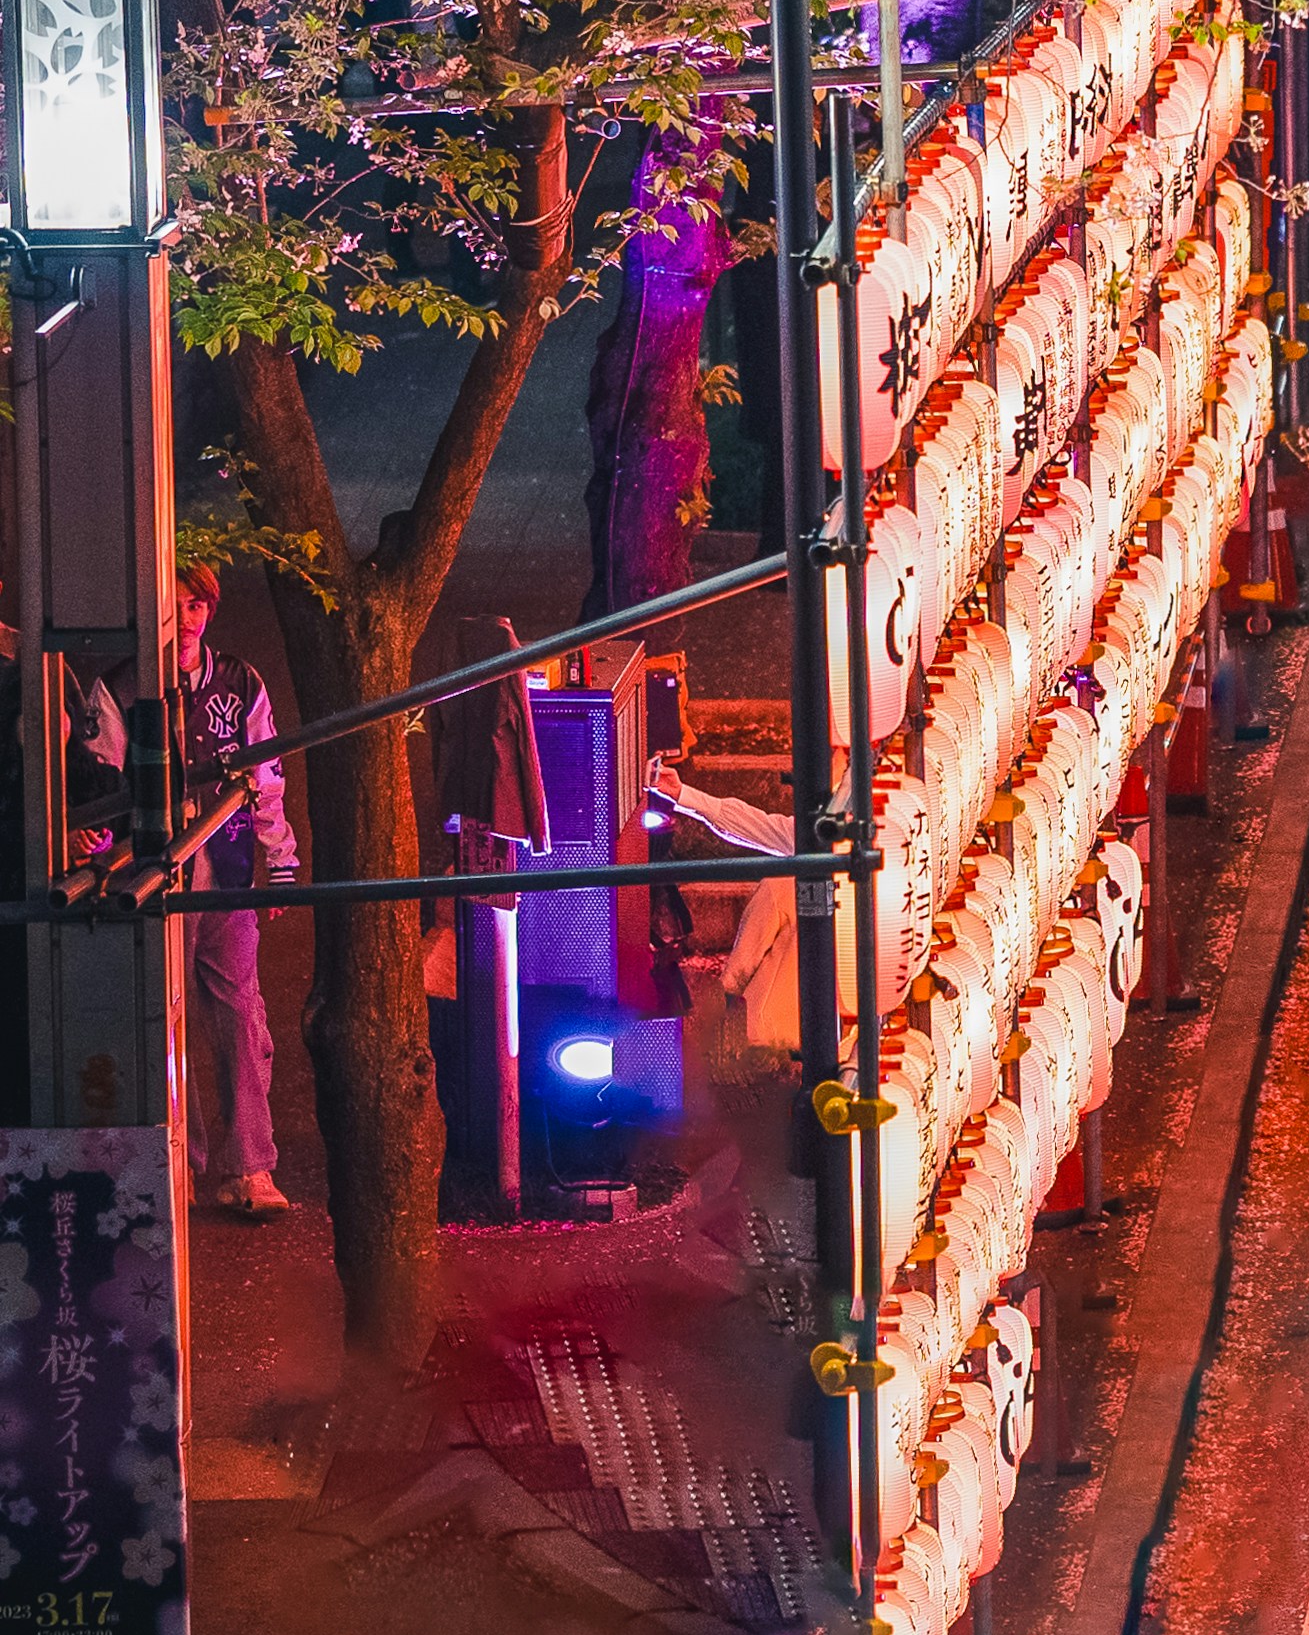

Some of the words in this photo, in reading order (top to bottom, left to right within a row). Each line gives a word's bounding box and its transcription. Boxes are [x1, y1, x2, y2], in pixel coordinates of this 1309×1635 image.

[205, 693, 244, 738] NY
[50, 1191, 79, 1328] 桜丘さくら坂
[38, 1333, 98, 1583] 桜ライトアップ
[0, 1604, 32, 1620] 023
[36, 1591, 114, 1627] 3.17
